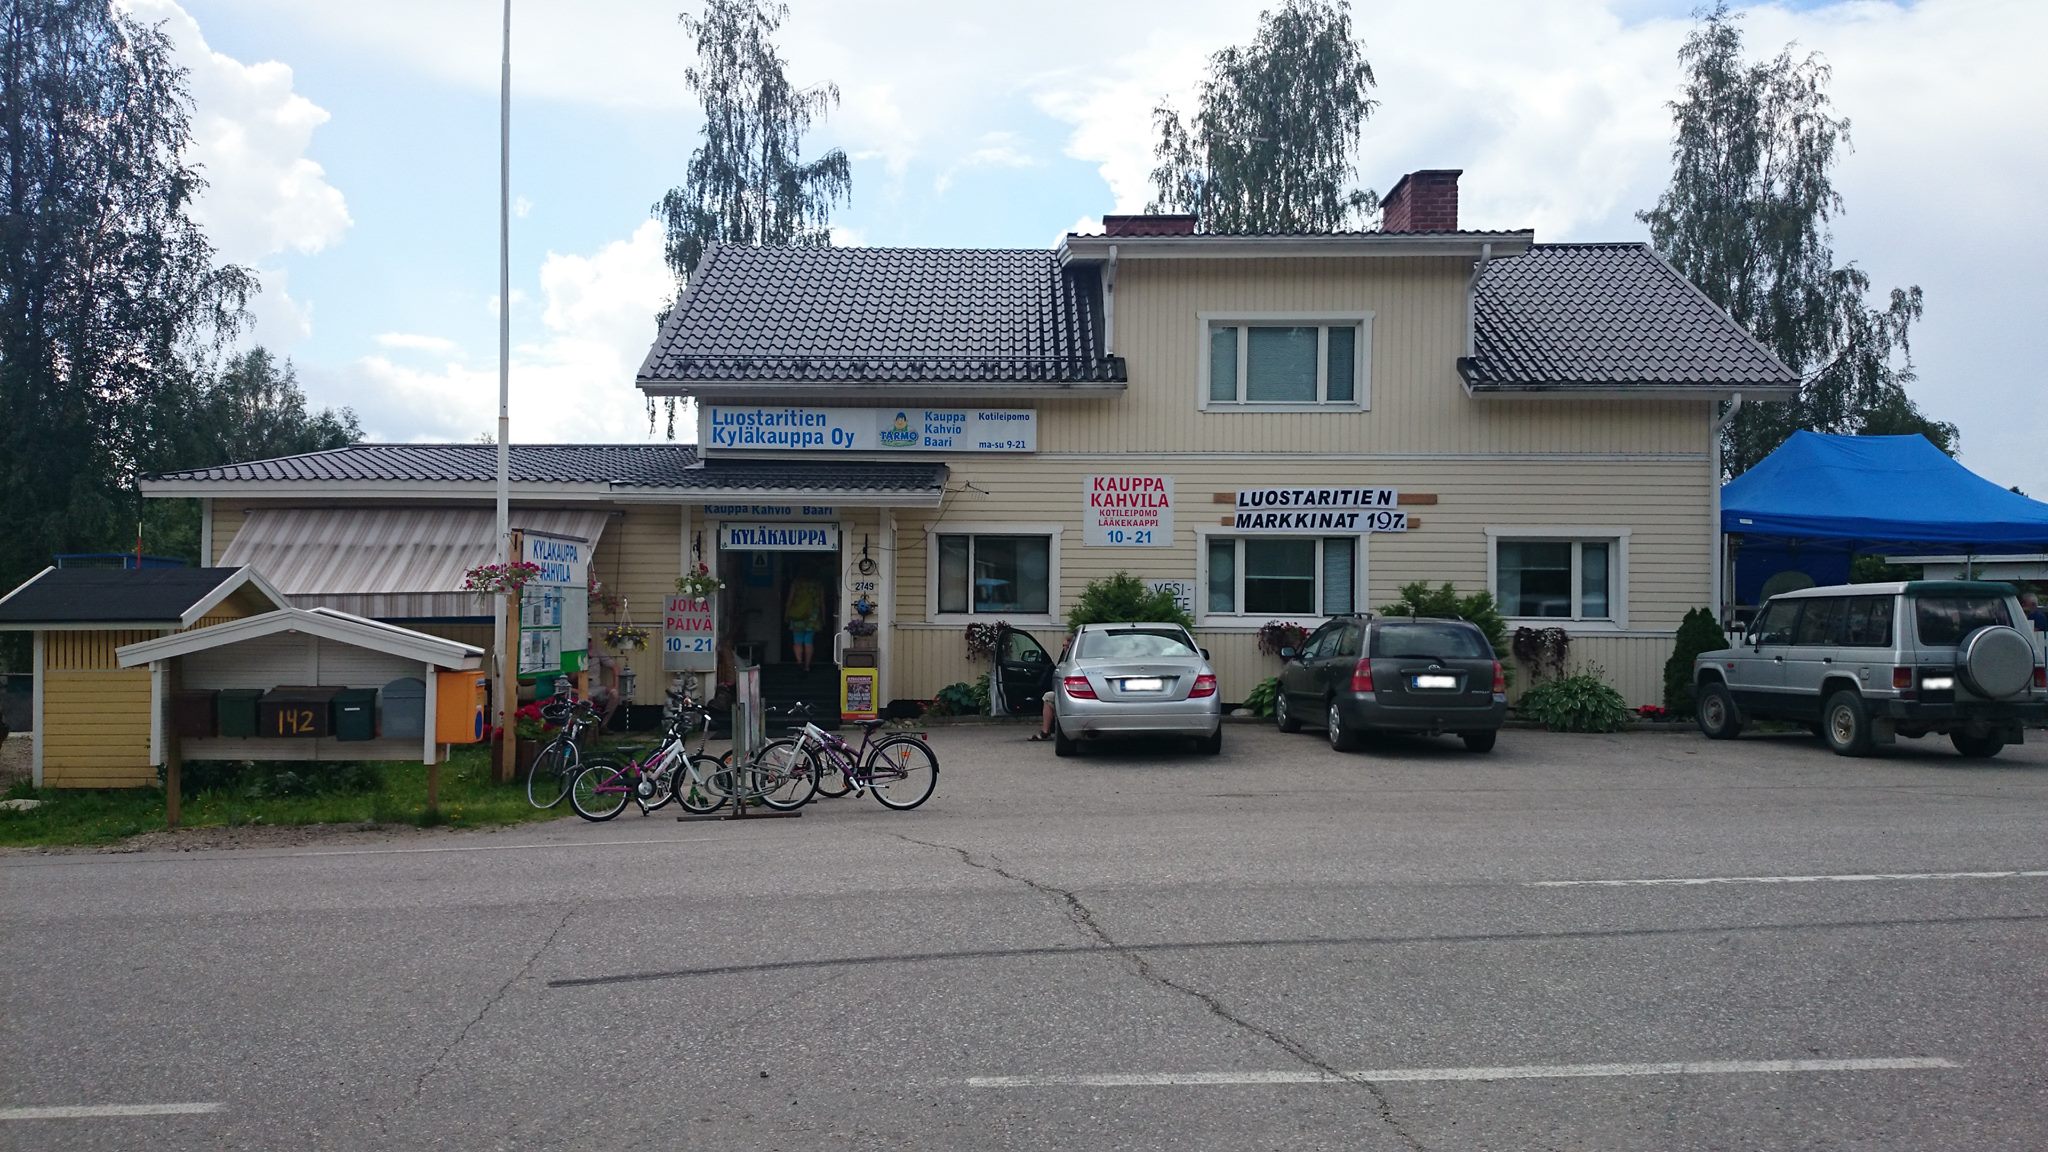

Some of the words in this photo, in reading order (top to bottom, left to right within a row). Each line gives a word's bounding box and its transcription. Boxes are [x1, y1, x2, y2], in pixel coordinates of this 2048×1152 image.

[712, 409, 826, 427] Luostaritien
[924, 411, 966, 423] Kauppa
[978, 412, 1030, 422] Kotileipomo
[924, 424, 962, 434] Kahvio
[712, 427, 824, 448] Kyläkauppa
[831, 427, 855, 449] Oy
[880, 431, 919, 442] TARMO
[924, 437, 952, 447] Baari
[979, 440, 1004, 449] ma-su
[1006, 440, 1026, 449] 9-21
[1093, 477, 1164, 491] KAUPPA
[1090, 493, 1169, 507] KAHVILA
[1238, 490, 1392, 507] LUOSTARITIEN
[704, 505, 748, 515] Kauppa
[751, 505, 791, 515] Kahvio
[803, 505, 833, 515] Baari
[1099, 509, 1158, 517] KOTILEIPOMO
[1098, 517, 1159, 526] LÄÄKEKAAPPI
[1235, 513, 1359, 529] MARKKINAT
[1366, 511, 1405, 531] 19.7.
[731, 526, 827, 545] KYLÄKAUPPA
[541, 562, 571, 582] KAHVILA
[855, 582, 874, 591] 2749
[670, 599, 710, 612] JOKA
[667, 614, 713, 631] PÄIVÄ
[279, 709, 315, 735] 142
